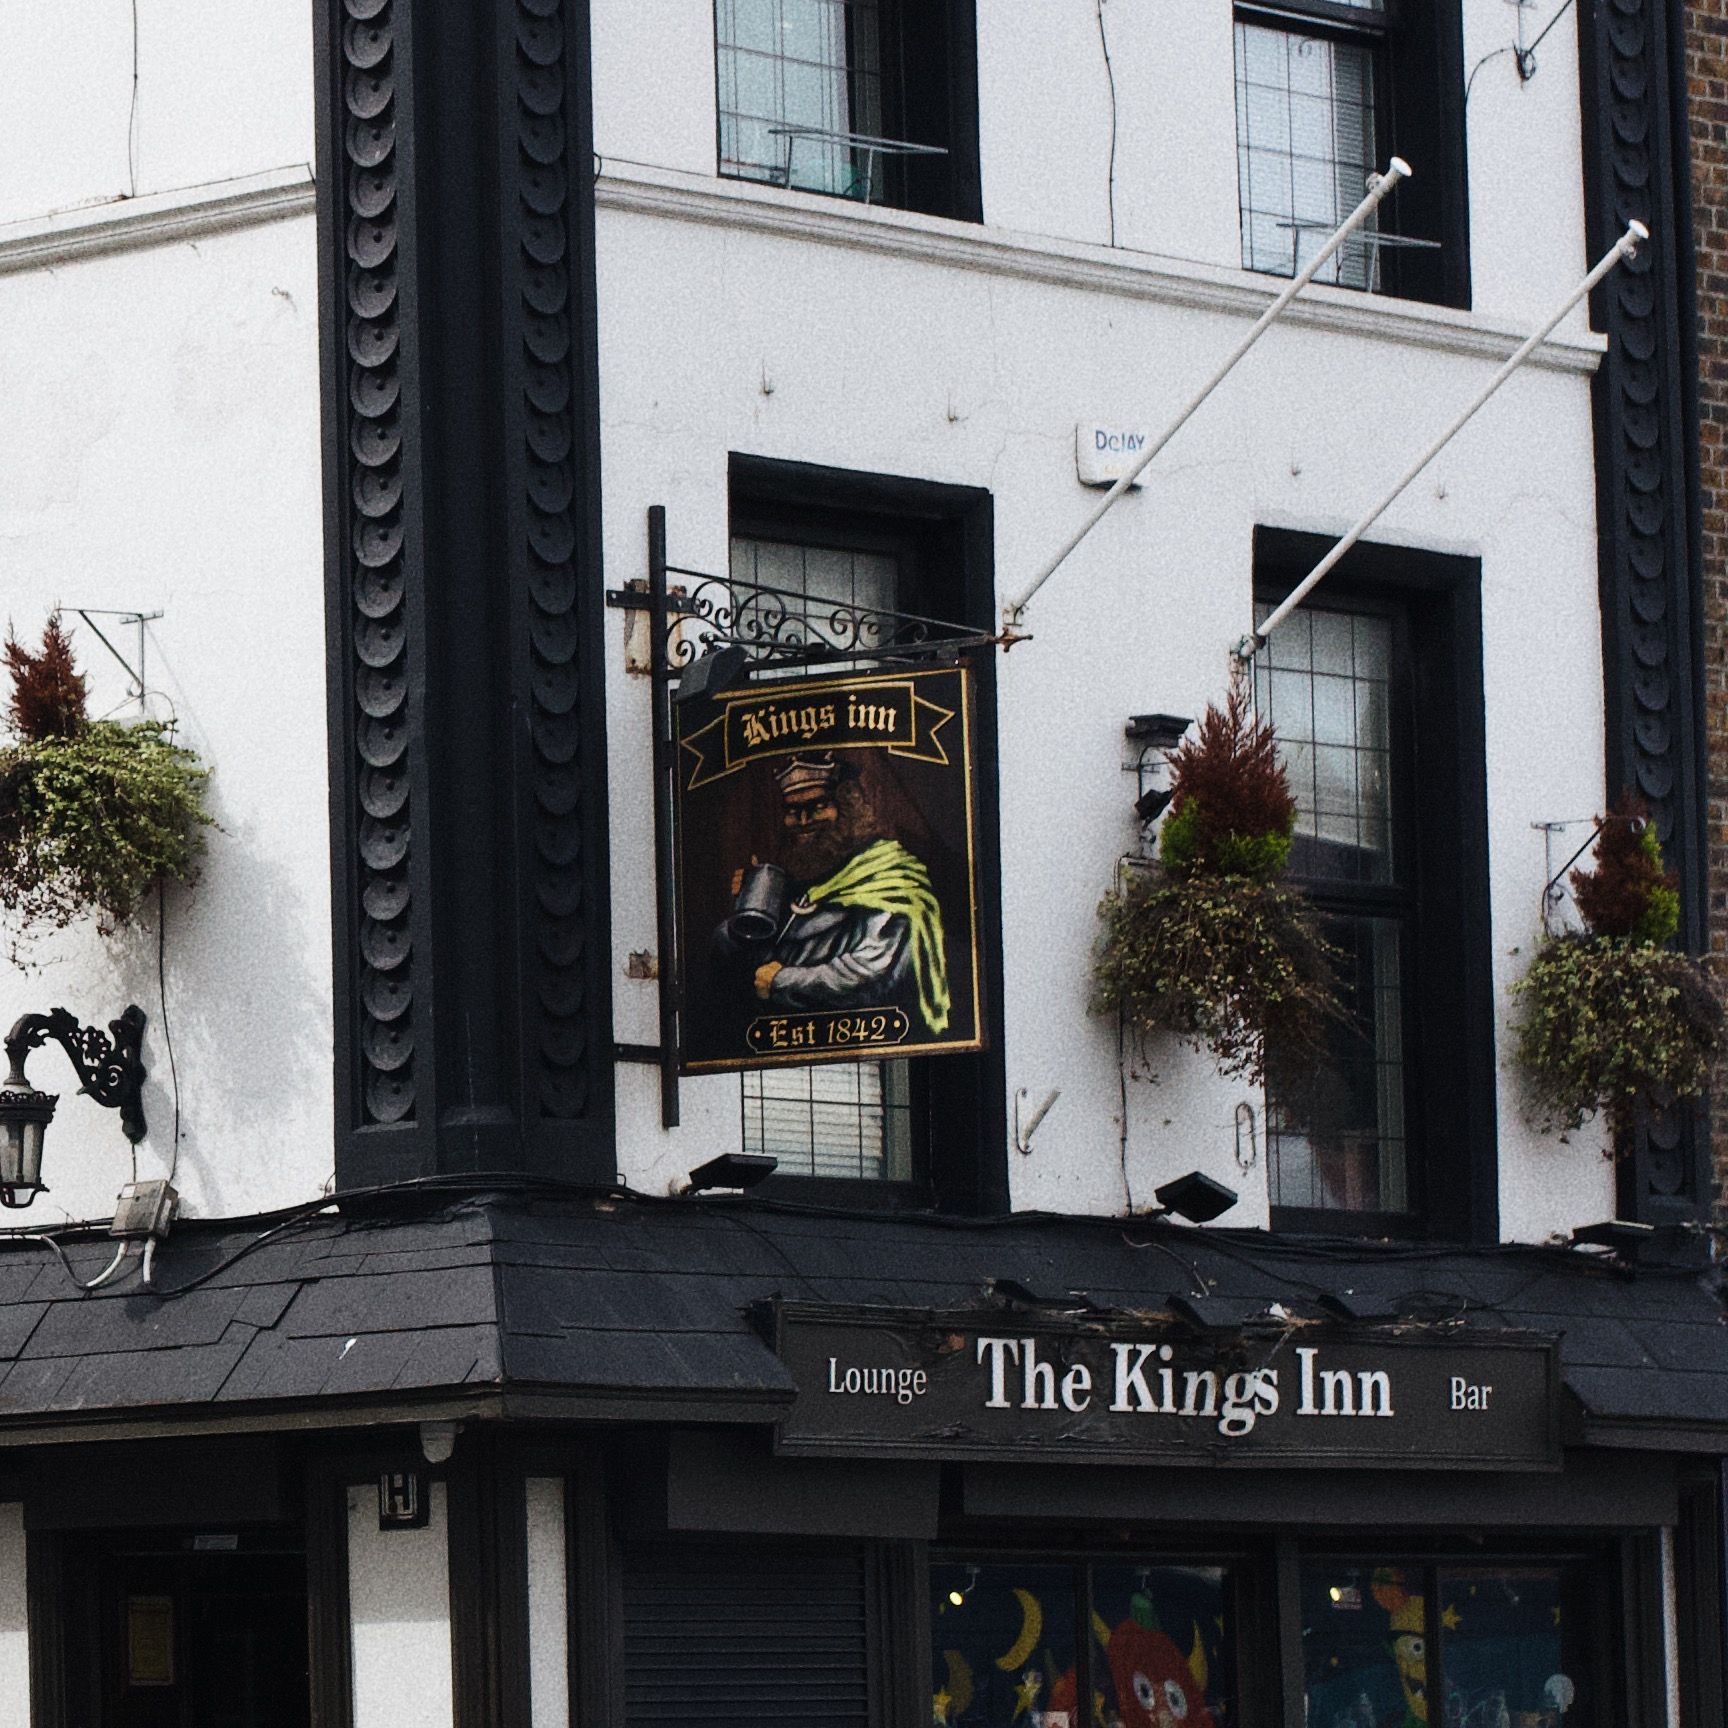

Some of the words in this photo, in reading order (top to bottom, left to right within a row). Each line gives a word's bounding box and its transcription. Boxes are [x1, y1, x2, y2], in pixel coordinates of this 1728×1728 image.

[741, 704, 836, 748] Kings
[848, 694, 897, 733] inn
[769, 1019, 816, 1047] Est
[827, 1015, 886, 1043] 1842
[828, 1357, 927, 1405] Lounge
[976, 1336, 1092, 1414] The
[1109, 1342, 1279, 1438] Kings
[1296, 1347, 1395, 1418] Inn
[1450, 1375, 1493, 1412] Bar
